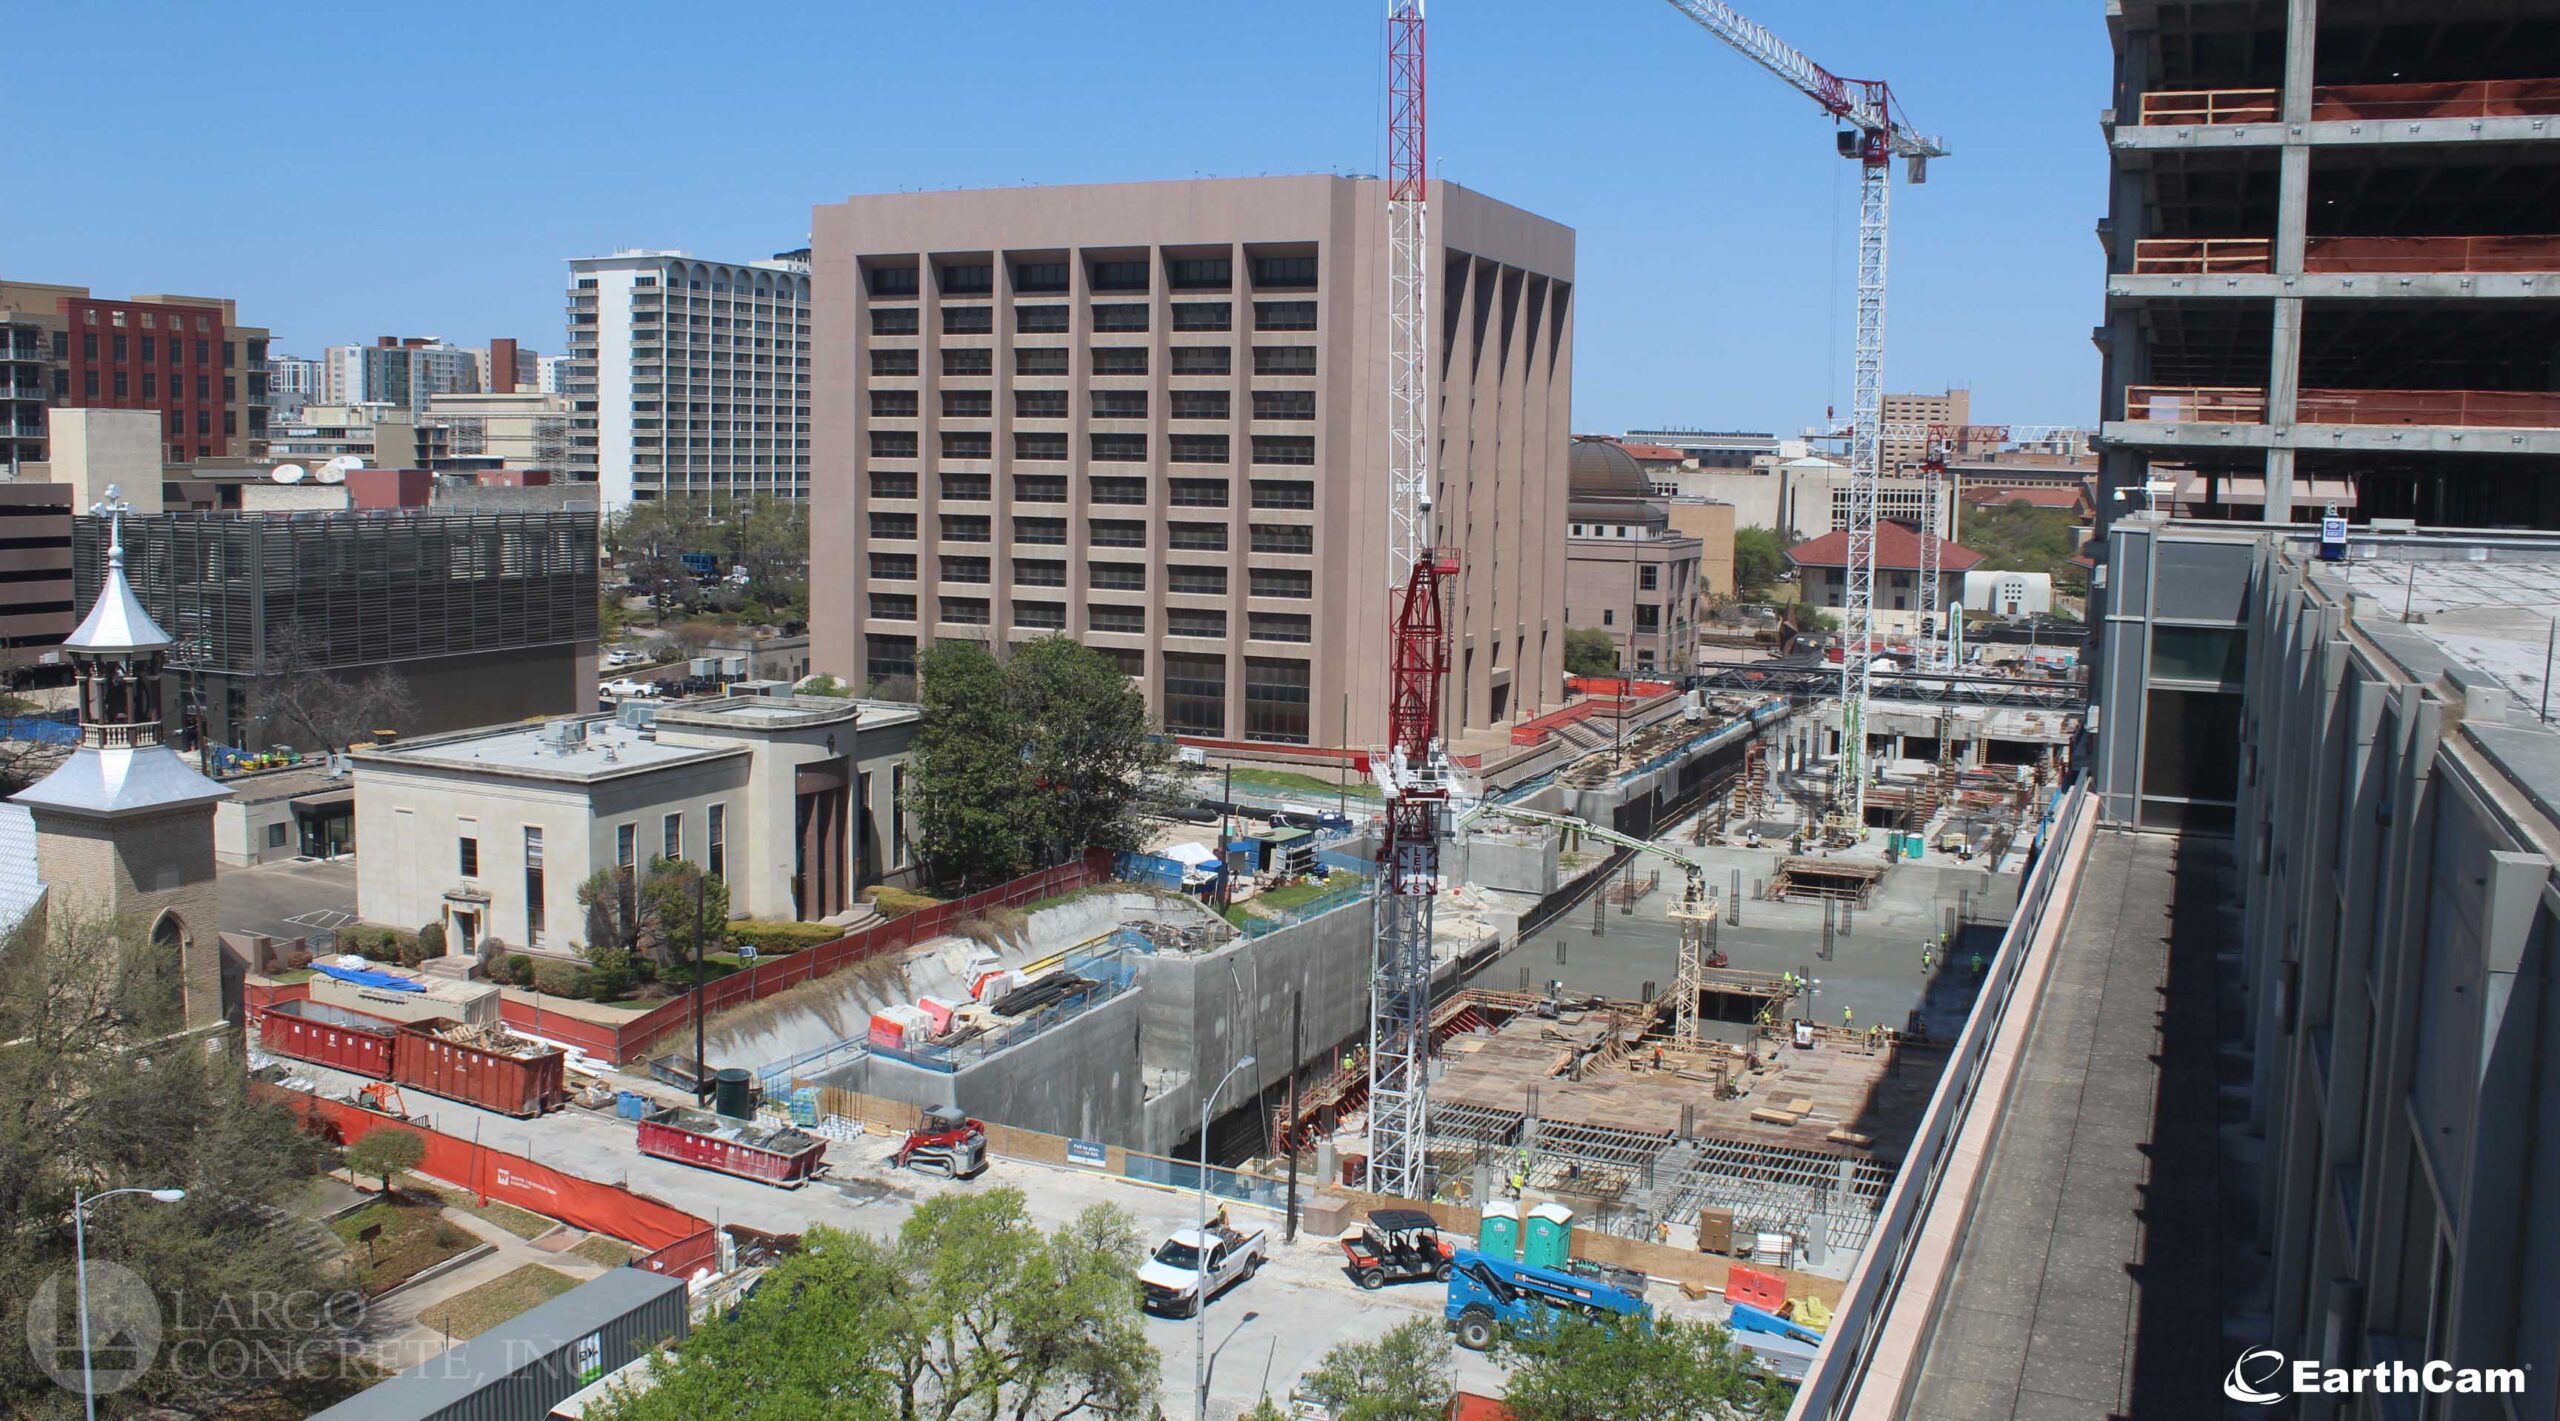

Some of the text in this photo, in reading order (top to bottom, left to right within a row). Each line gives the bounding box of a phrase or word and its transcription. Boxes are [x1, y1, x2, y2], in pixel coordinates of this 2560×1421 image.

[1412, 846, 1421, 895] LEWIS
[294, 1025, 371, 1050] RECON
[428, 1042, 495, 1068] RECON
